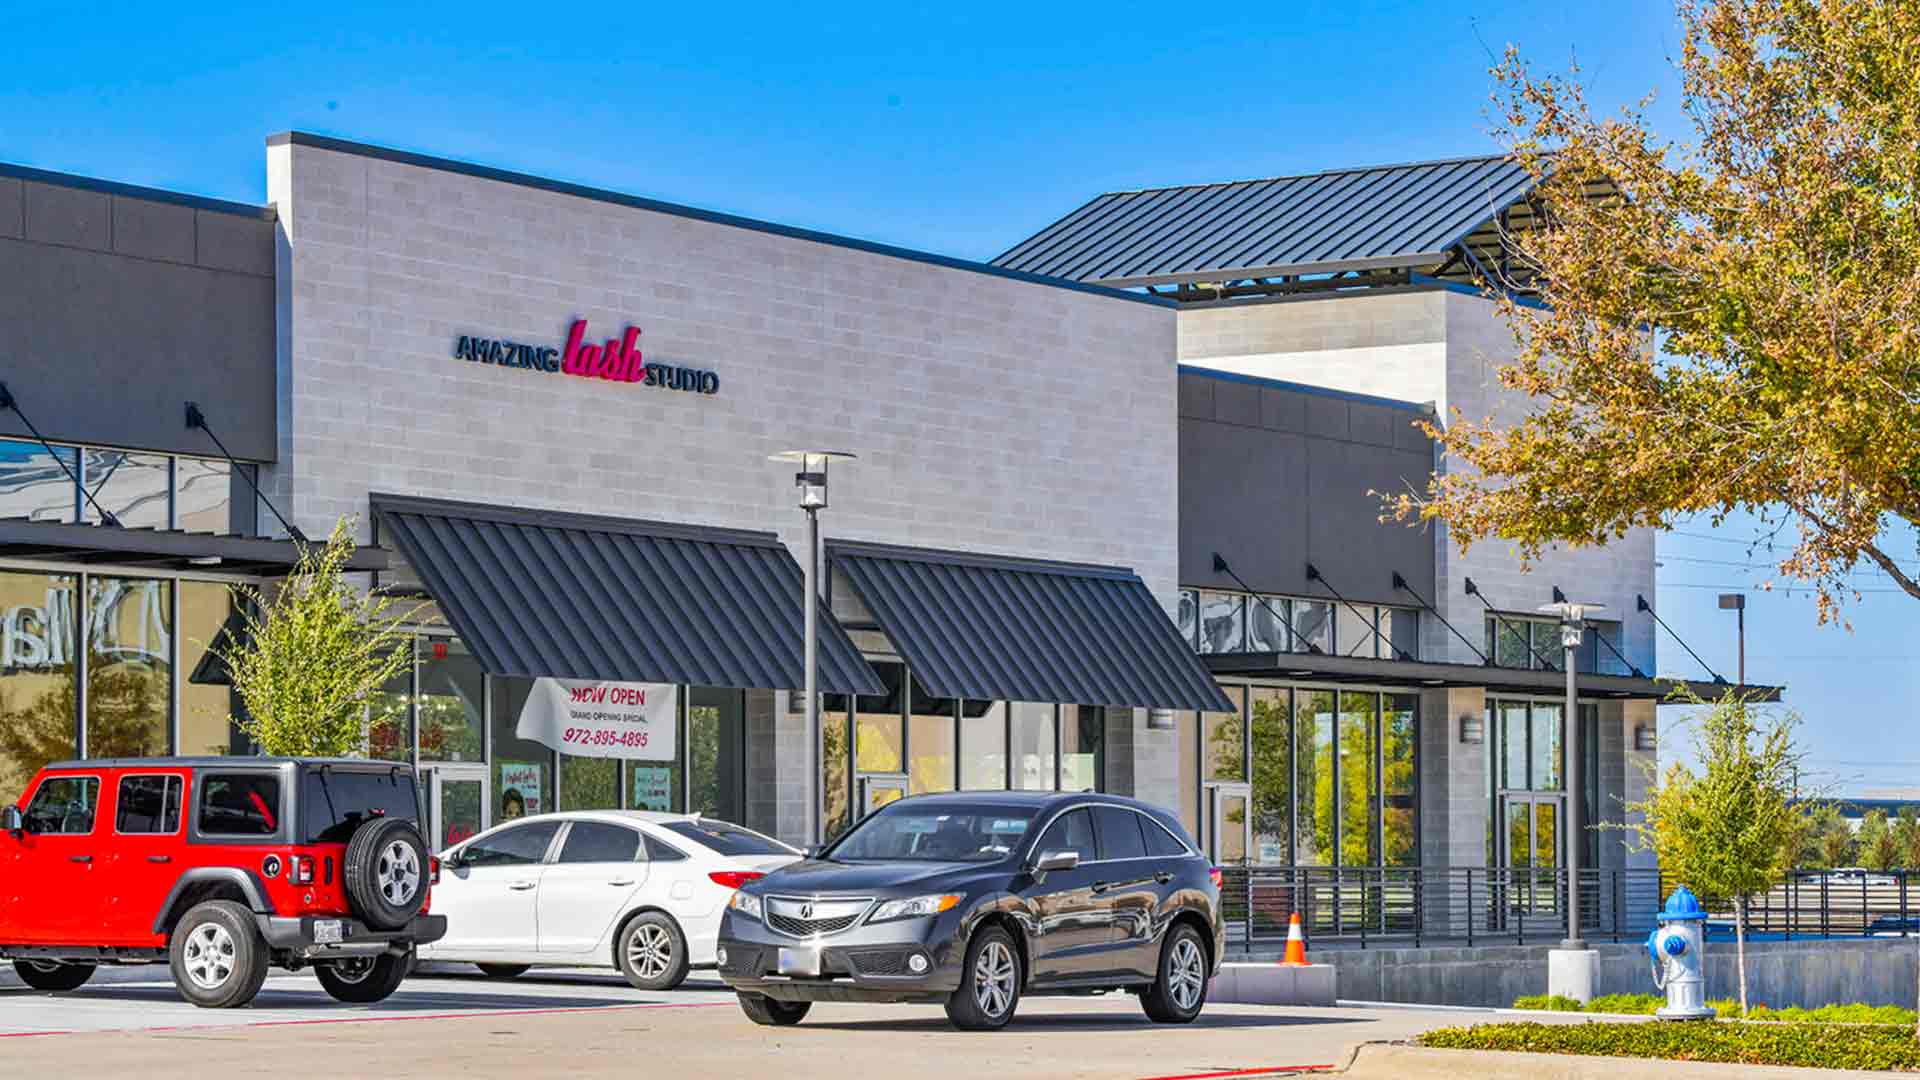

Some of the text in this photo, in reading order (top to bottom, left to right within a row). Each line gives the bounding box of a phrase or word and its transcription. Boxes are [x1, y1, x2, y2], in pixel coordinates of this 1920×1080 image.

[455, 319, 720, 395] AMAZING lash STUDIO
[570, 687, 646, 705] NOW OPEN
[592, 711, 622, 722] OPENING
[563, 727, 648, 748] 972-895-4895
